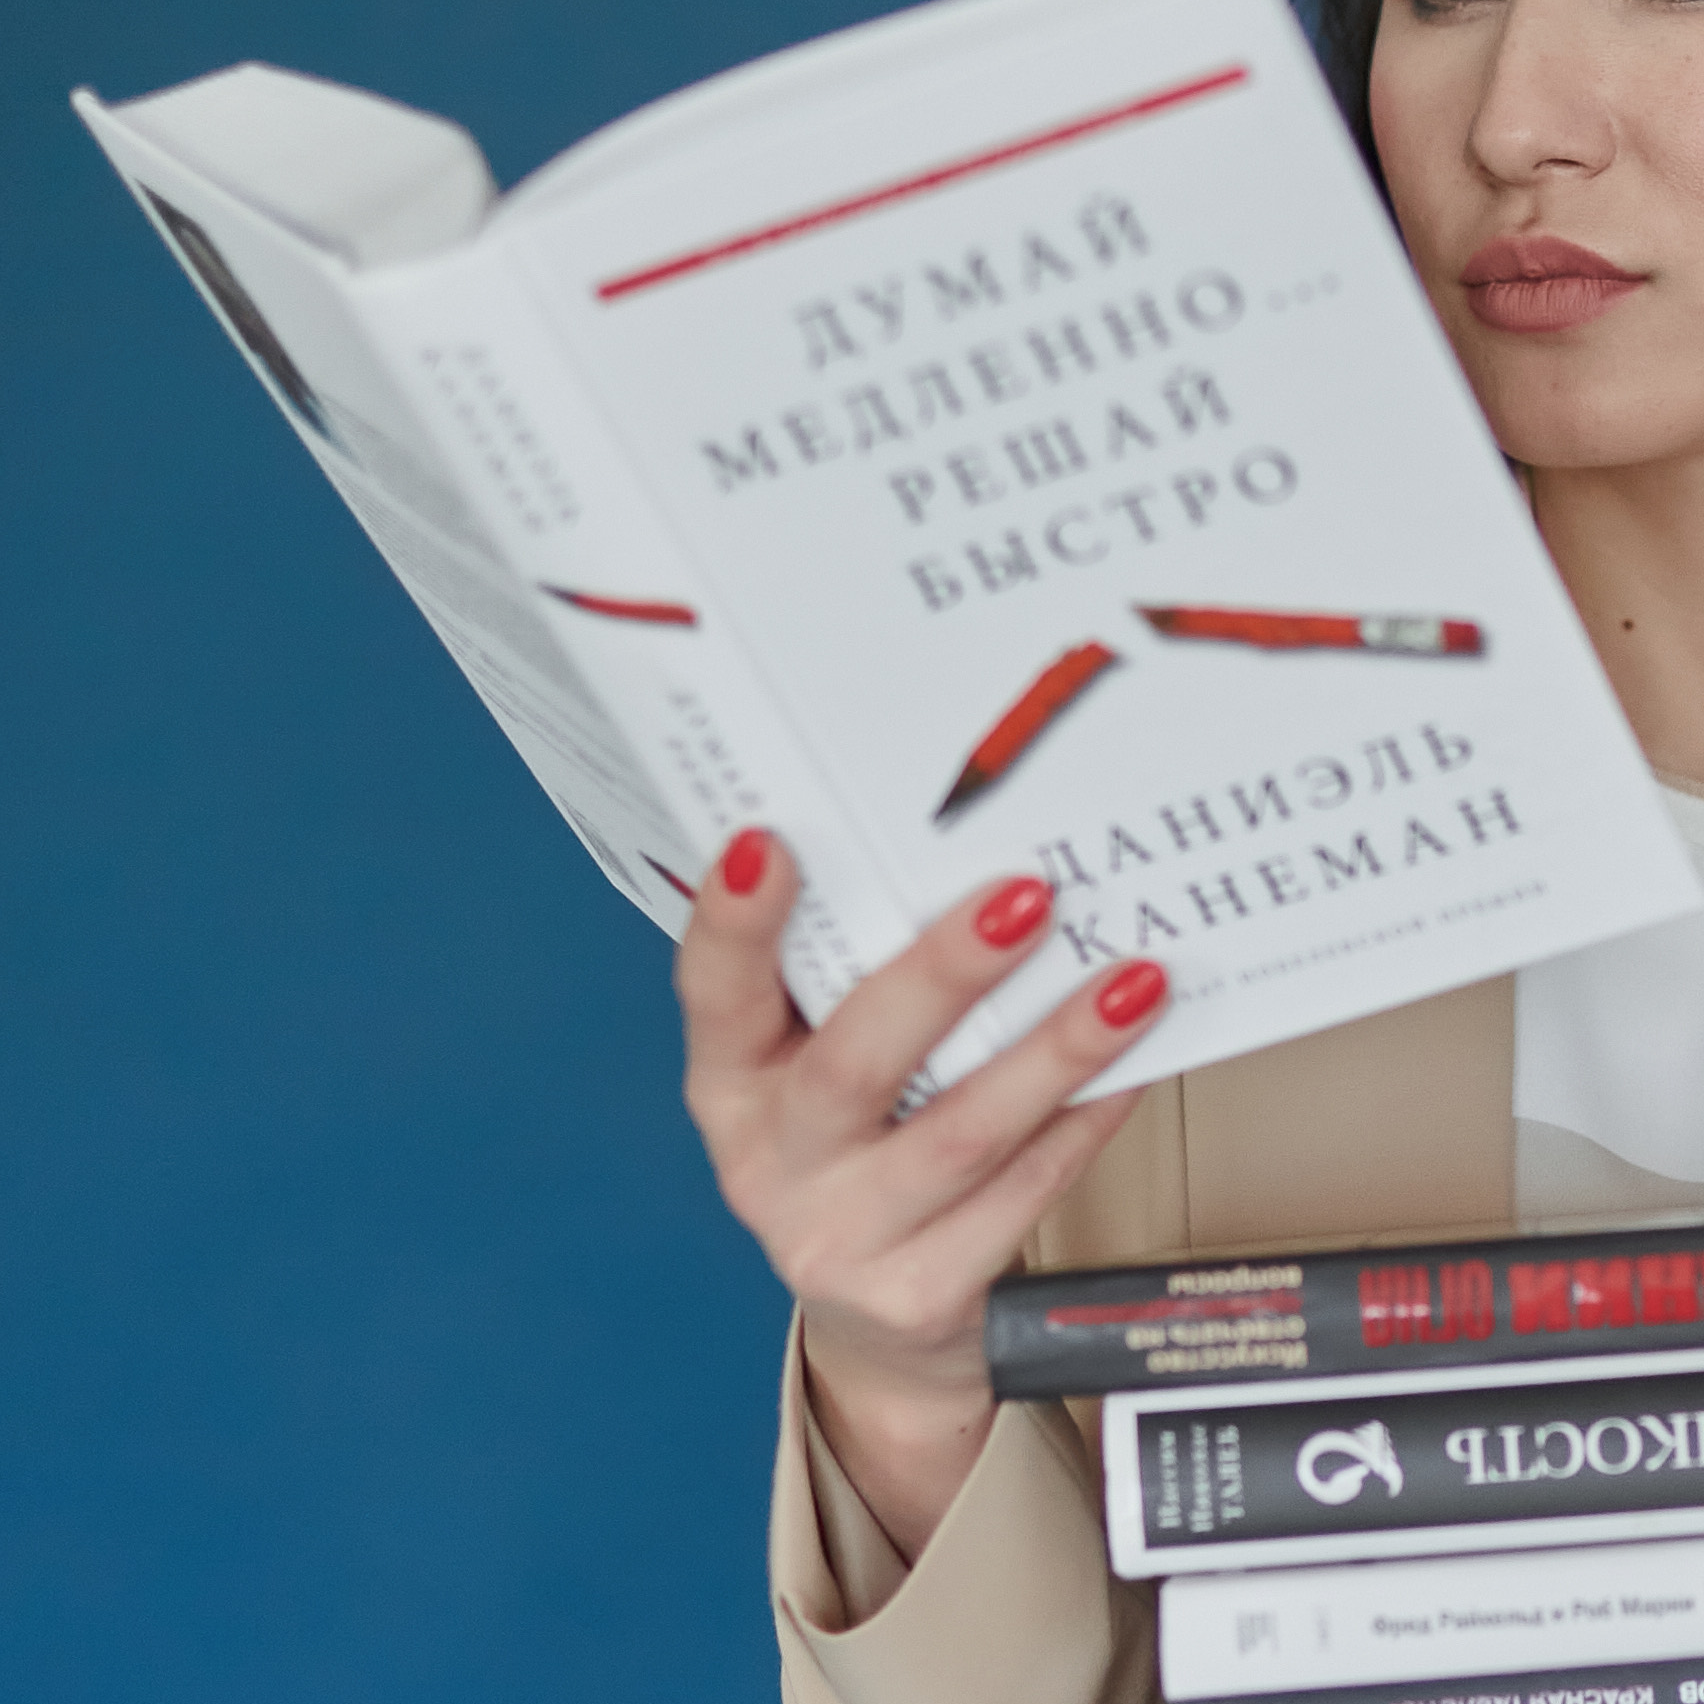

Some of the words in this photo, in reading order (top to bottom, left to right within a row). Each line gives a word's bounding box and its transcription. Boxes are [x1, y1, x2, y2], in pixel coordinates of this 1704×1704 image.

[793, 191, 1153, 372] ДУМАЙ
[887, 366, 1236, 527] РЕШАЙ
[905, 444, 1301, 615] БЫСТРО
[1034, 718, 1479, 896] ДАНИЭЛЬ
[1058, 786, 1525, 968] КАНЕМАН
[1359, 1260, 1495, 1347] ОГНЯ
